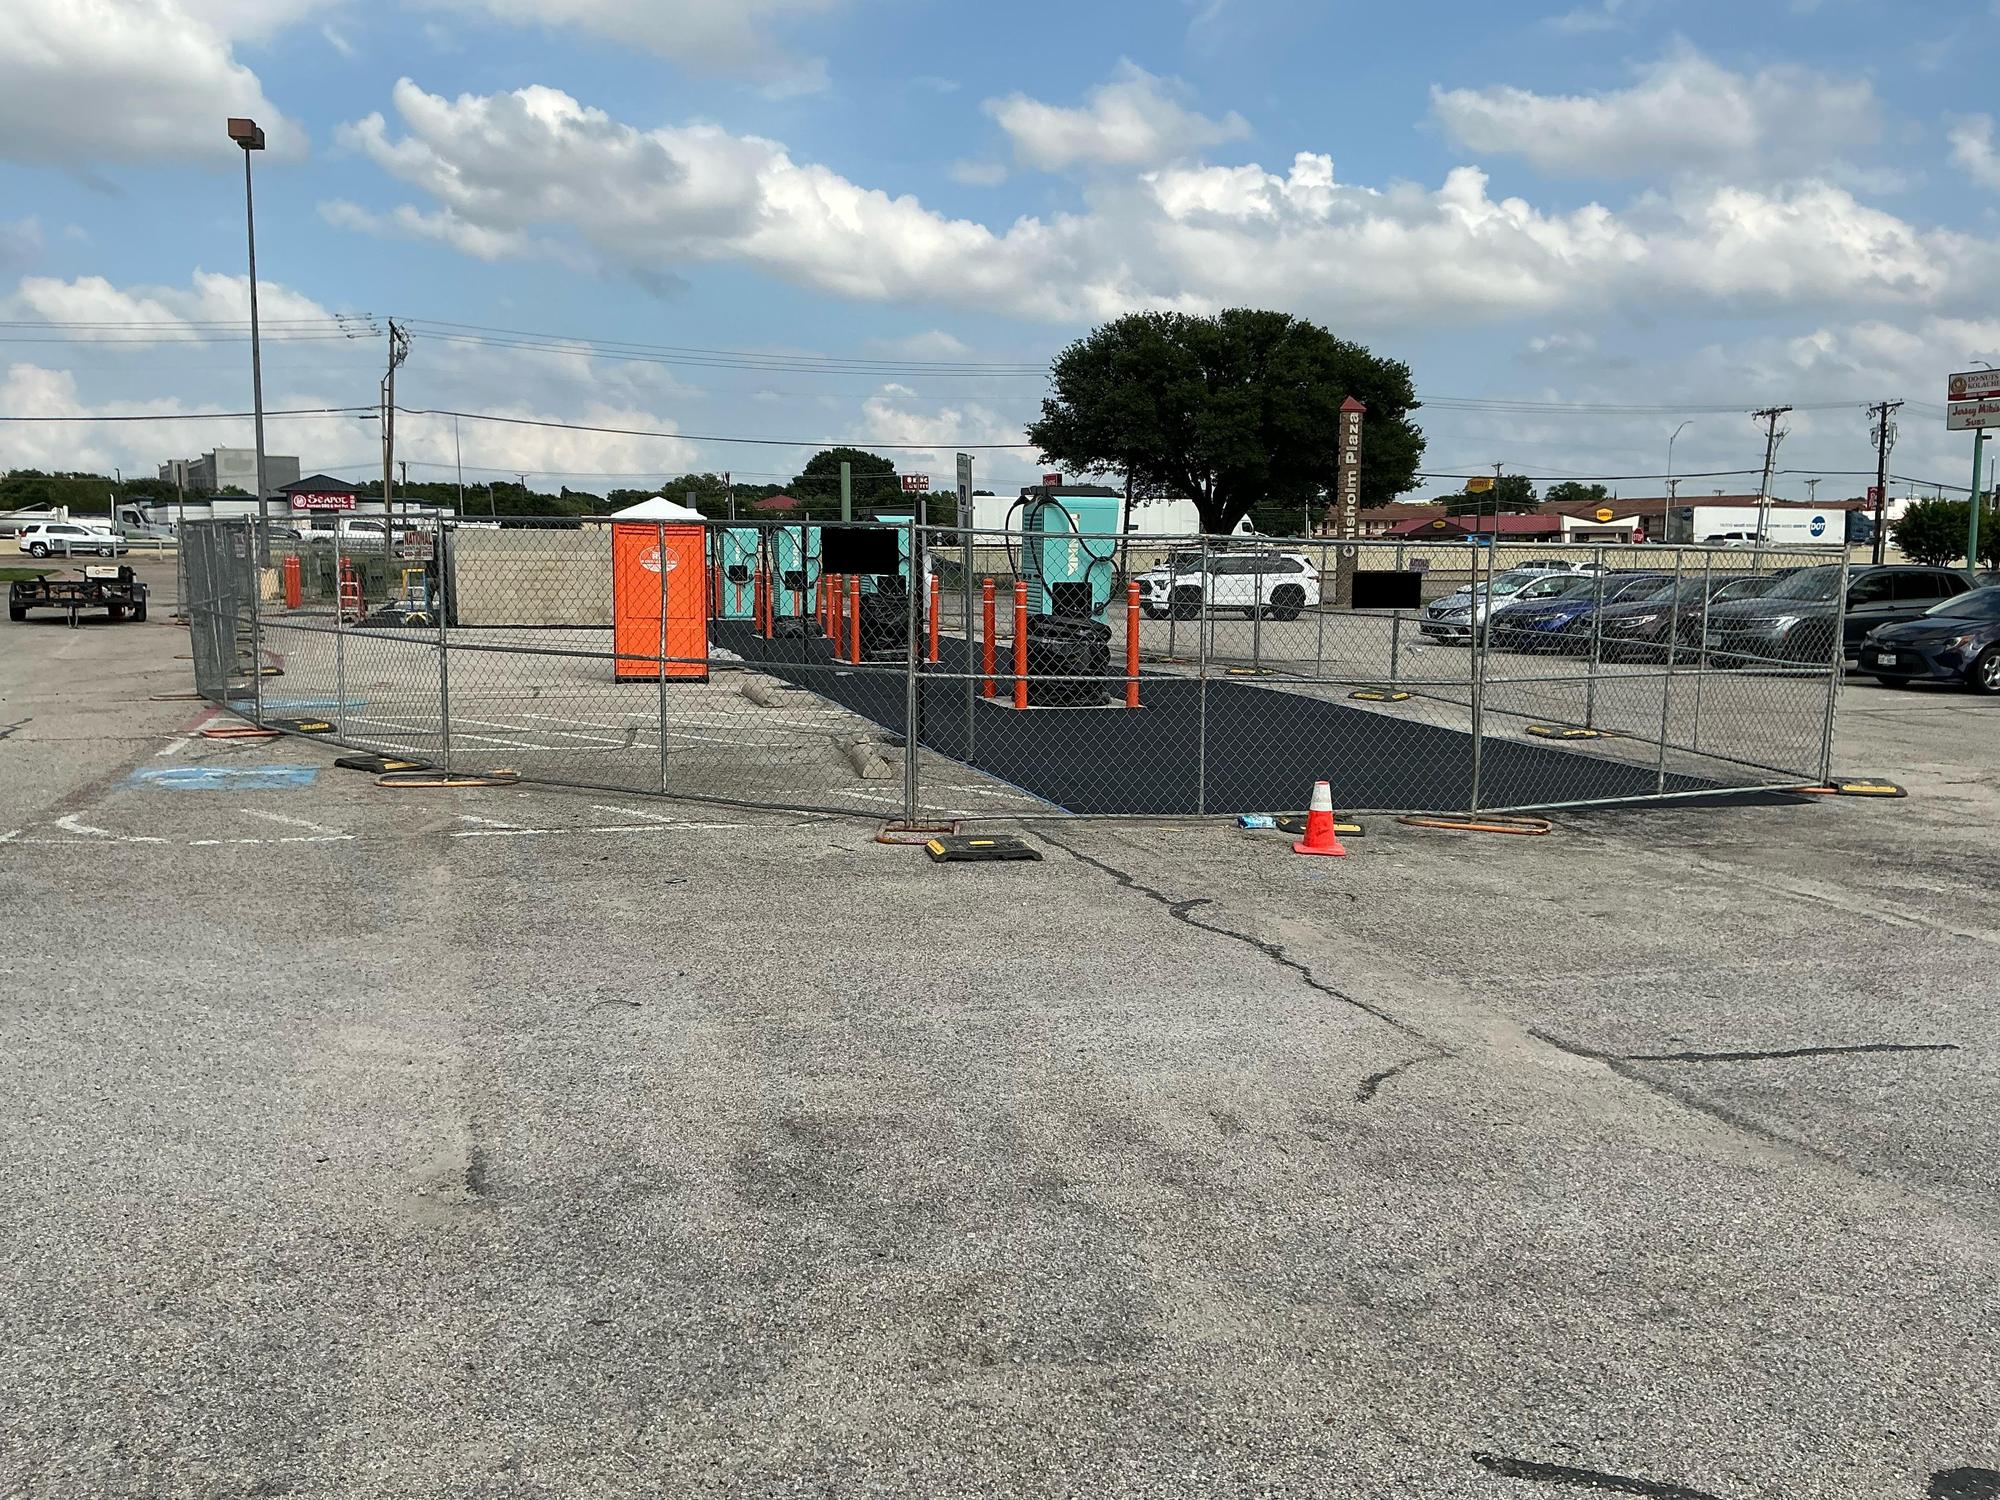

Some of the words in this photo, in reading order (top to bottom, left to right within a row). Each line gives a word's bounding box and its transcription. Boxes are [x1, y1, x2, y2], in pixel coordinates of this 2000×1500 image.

[1952, 405, 1977, 417] Jersey
[1345, 412, 1359, 464] Plaza
[1810, 522, 1825, 530] DOT
